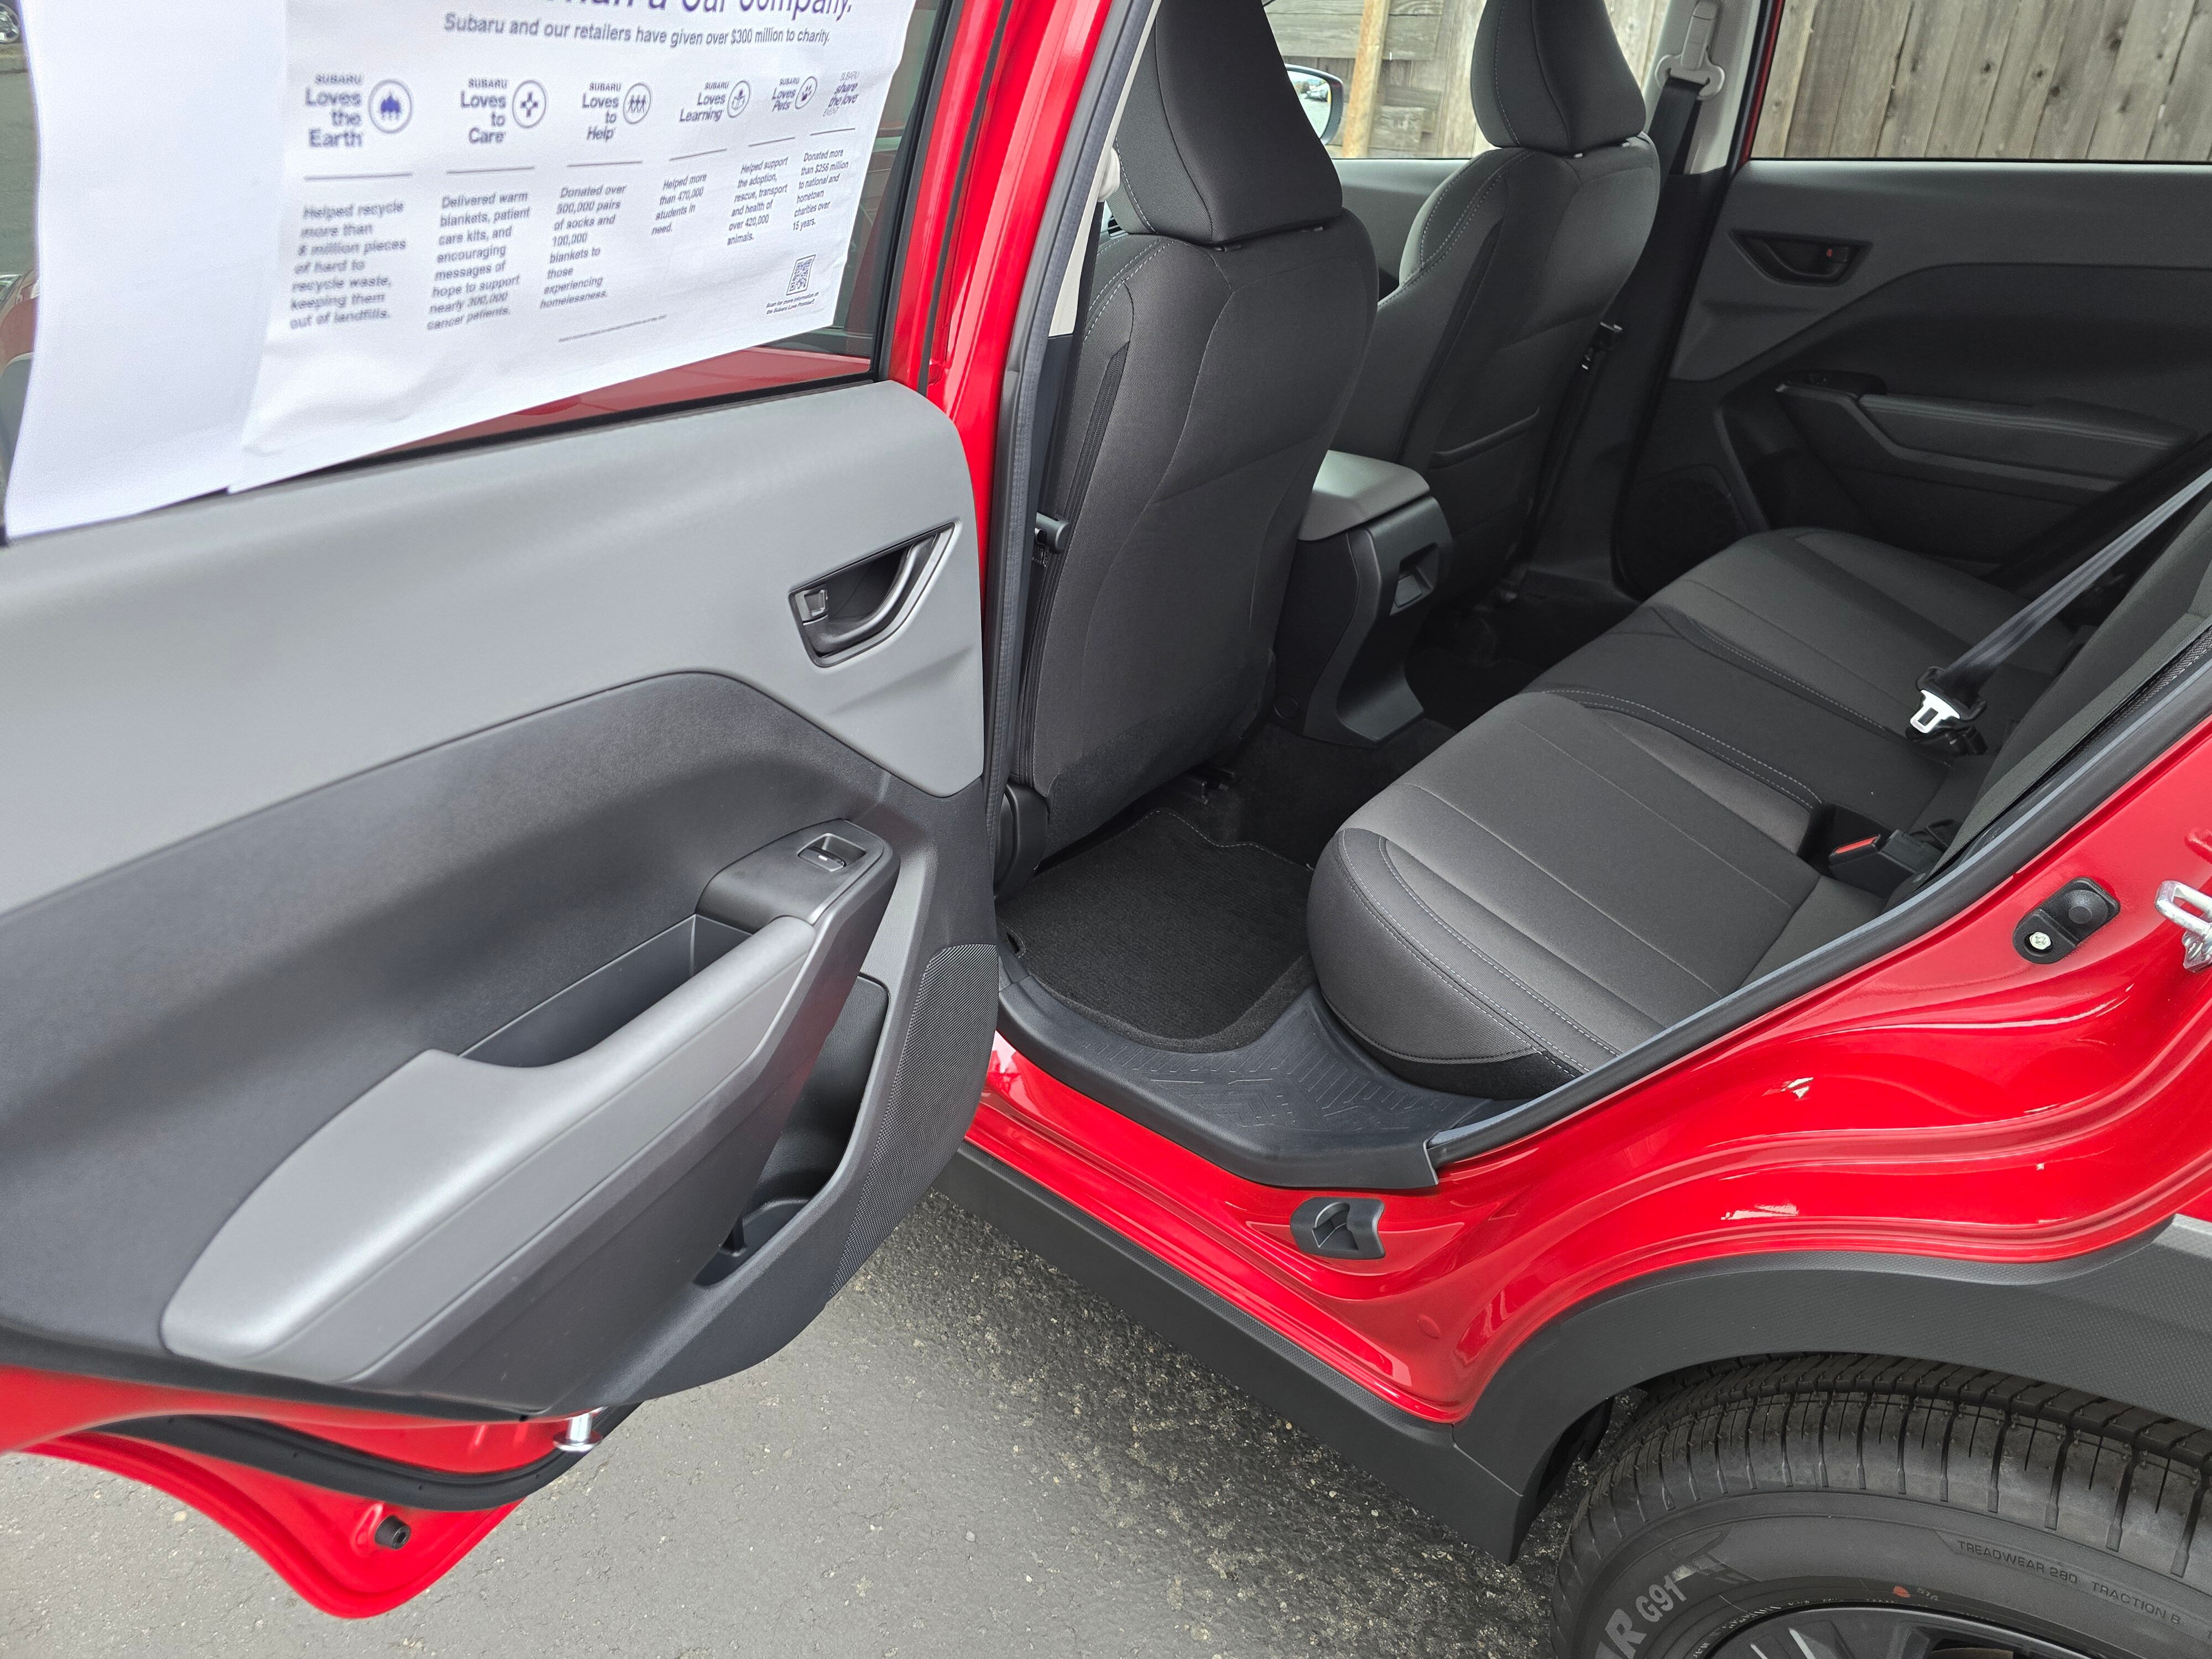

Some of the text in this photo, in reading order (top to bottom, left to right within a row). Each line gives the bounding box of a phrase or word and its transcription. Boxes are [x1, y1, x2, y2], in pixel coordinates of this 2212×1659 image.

[444, 12, 830, 49] Subaru and our retailers have given over $300 million to charity.
[468, 78, 507, 88] SUBARU
[589, 83, 621, 91] SUBARU
[705, 81, 729, 90] SUBARU
[779, 77, 800, 86] SUBARU
[834, 82, 858, 95] share
[306, 87, 361, 106] Loves
[461, 91, 506, 108] Loves
[582, 93, 619, 108] Loves
[697, 93, 725, 106] Loves
[772, 87, 796, 100] Loves
[772, 100, 791, 112] Pets
[331, 111, 361, 126] the
[492, 112, 505, 127] to
[605, 113, 617, 123] to
[679, 107, 722, 122] Learning
[309, 128, 362, 147] Earth
[468, 127, 504, 143] Care
[804, 149, 843, 162] Donated more
[740, 157, 788, 174] Helped support
[801, 161, 848, 176] than $256 million
[663, 174, 707, 191] Helped more
[737, 173, 777, 189] the adoption,
[799, 174, 840, 189] to national and
[442, 192, 528, 208] Delivered warm
[560, 185, 627, 199] Donated over
[660, 187, 703, 206] than 470,000
[734, 184, 787, 203] rescue, transport
[796, 190, 824, 204] hometown
[557, 200, 620, 215] 500,000 pairs
[655, 204, 696, 221] students in
[731, 200, 773, 217] and health of
[794, 201, 830, 217] charities over
[440, 207, 530, 227] blankets, patient
[554, 215, 615, 231] of socks and
[729, 214, 769, 231] over 420,000
[793, 218, 816, 231] 15 years.
[439, 226, 512, 246] care kits, and
[651, 222, 672, 236] need.
[552, 233, 588, 247] 100,000
[727, 233, 754, 246] animals.
[437, 246, 506, 263] encouraging
[550, 247, 601, 264] blankets to
[435, 260, 506, 280] messages of
[547, 268, 573, 279] those
[431, 275, 520, 298] hope to support
[544, 276, 603, 295] experiencing
[429, 301, 464, 314] nearly
[540, 290, 608, 310] homelessness.
[427, 307, 510, 330] cancer patients.
[1958, 1540, 2078, 1584] TREADWEAR 280
[2091, 1581, 2166, 1618] TRACTION
[1595, 1608, 1647, 1659] R
[1635, 1575, 1687, 1623] G91
